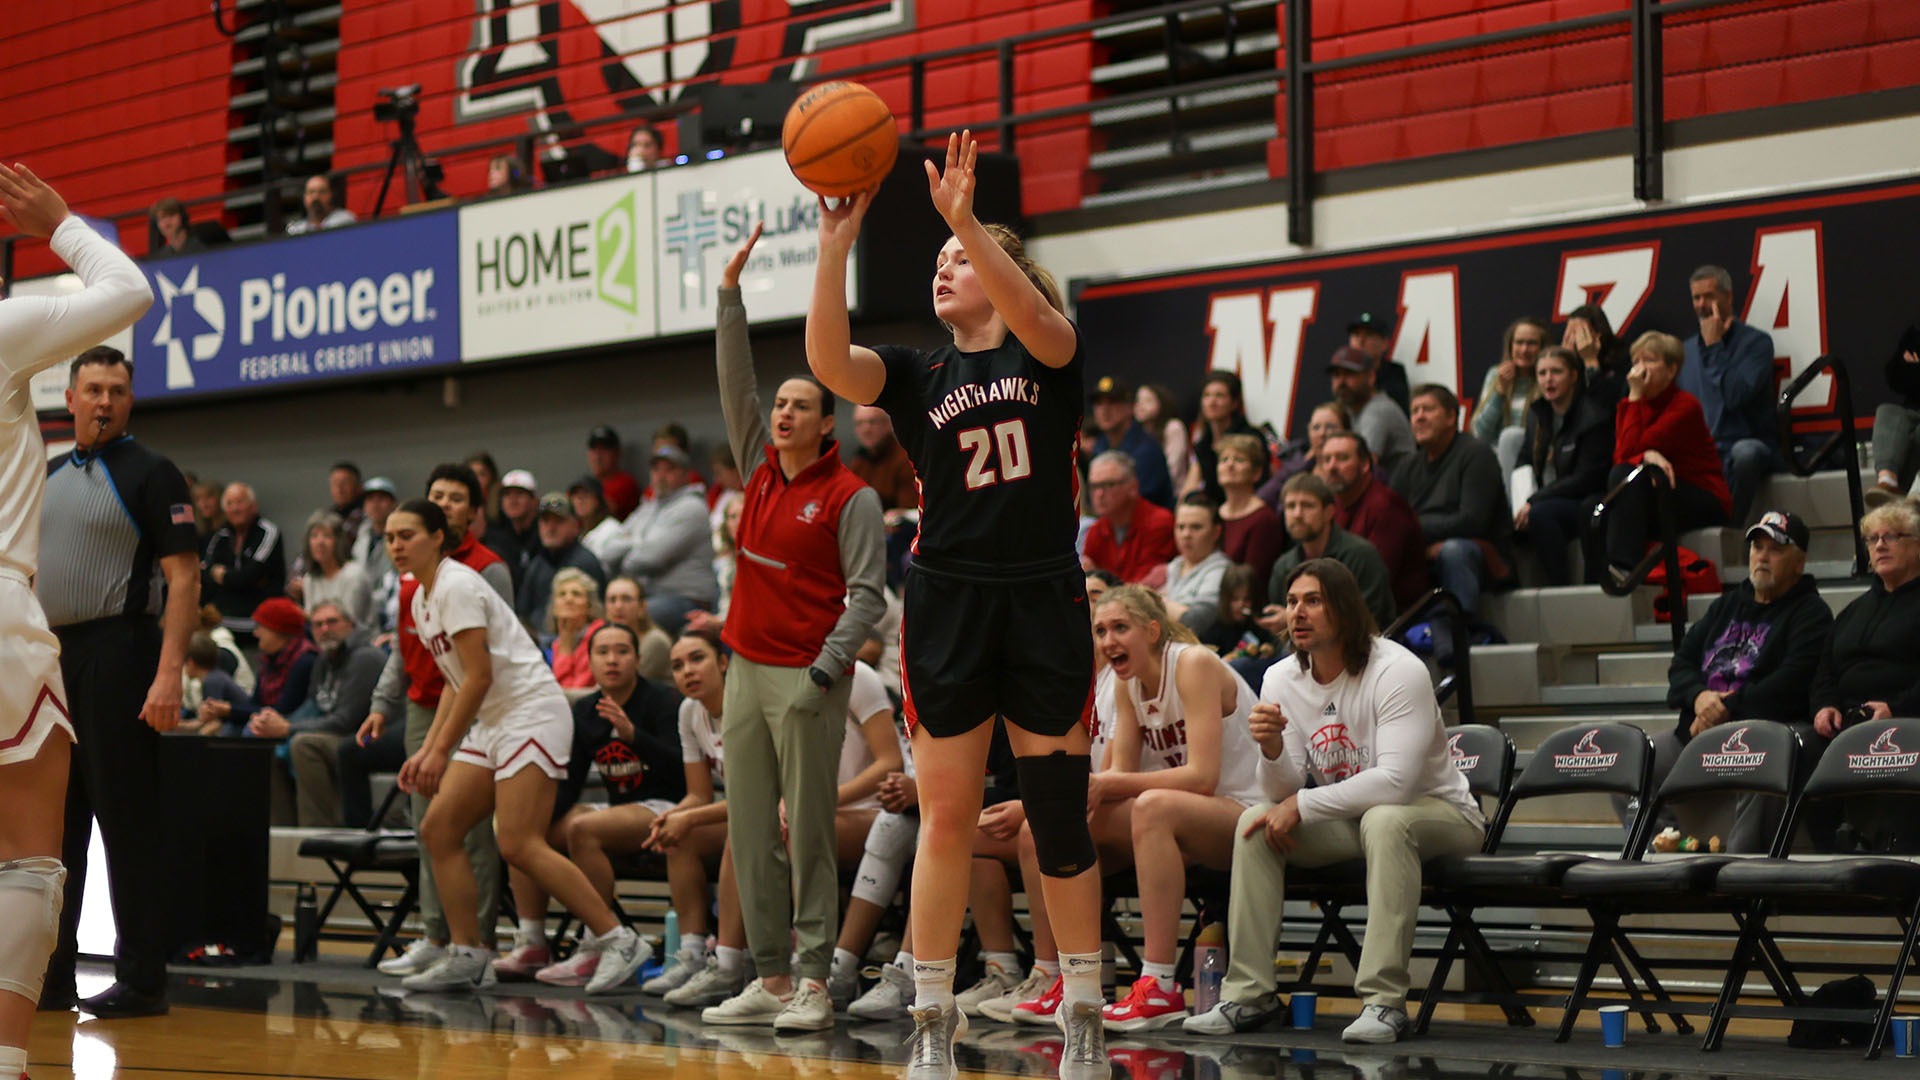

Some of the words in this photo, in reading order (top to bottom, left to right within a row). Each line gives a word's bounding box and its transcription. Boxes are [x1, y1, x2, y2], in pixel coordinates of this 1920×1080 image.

[476, 222, 591, 295] HOME
[599, 203, 635, 306] 2
[240, 351, 311, 382] FEDERAL
[314, 341, 375, 373] CREDIT
[378, 334, 434, 366] UNION
[928, 376, 1040, 431] NIGHTHAWKS
[957, 416, 1031, 491] 20
[1555, 754, 1617, 767] NIGHTHAWKS
[1703, 753, 1764, 766] NIGHTHAWKS
[1850, 753, 1917, 767] NIGHTHAWKS
